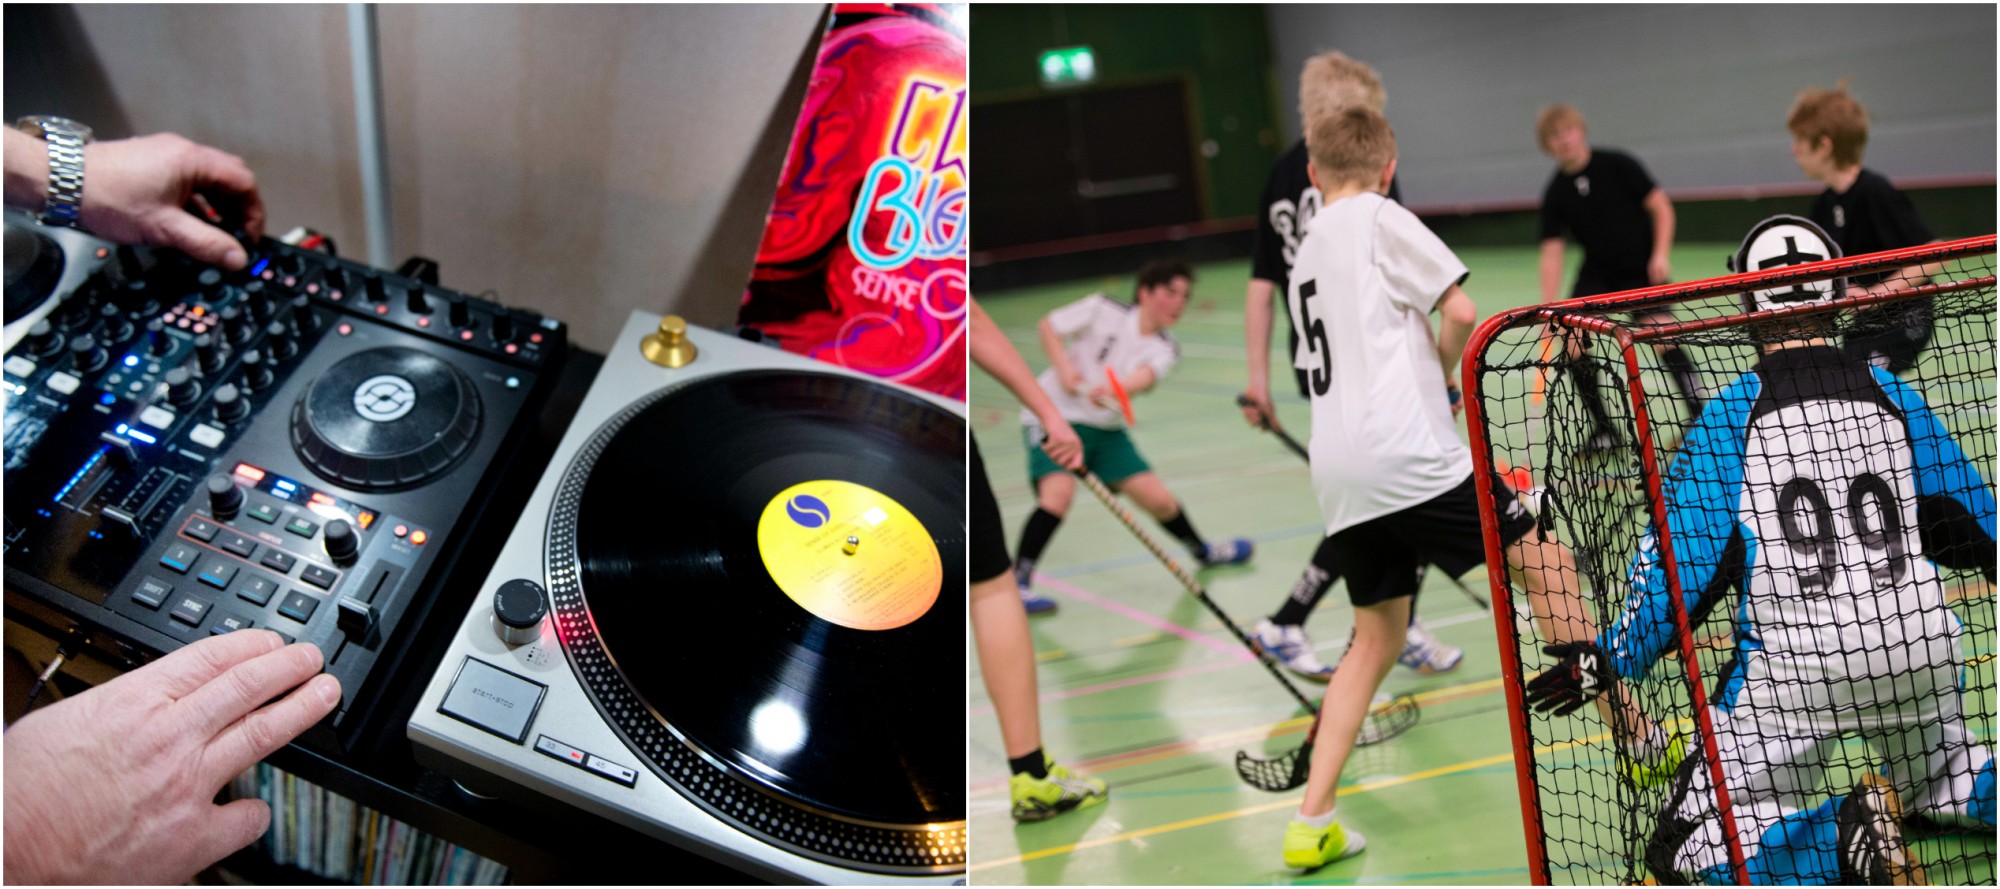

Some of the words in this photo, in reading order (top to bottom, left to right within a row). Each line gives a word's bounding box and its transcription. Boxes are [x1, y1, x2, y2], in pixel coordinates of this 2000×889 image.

[851, 265, 920, 311] SENSE
[1298, 278, 1332, 397] 5
[1778, 472, 1907, 597] 99
[224, 618, 241, 630] CUE
